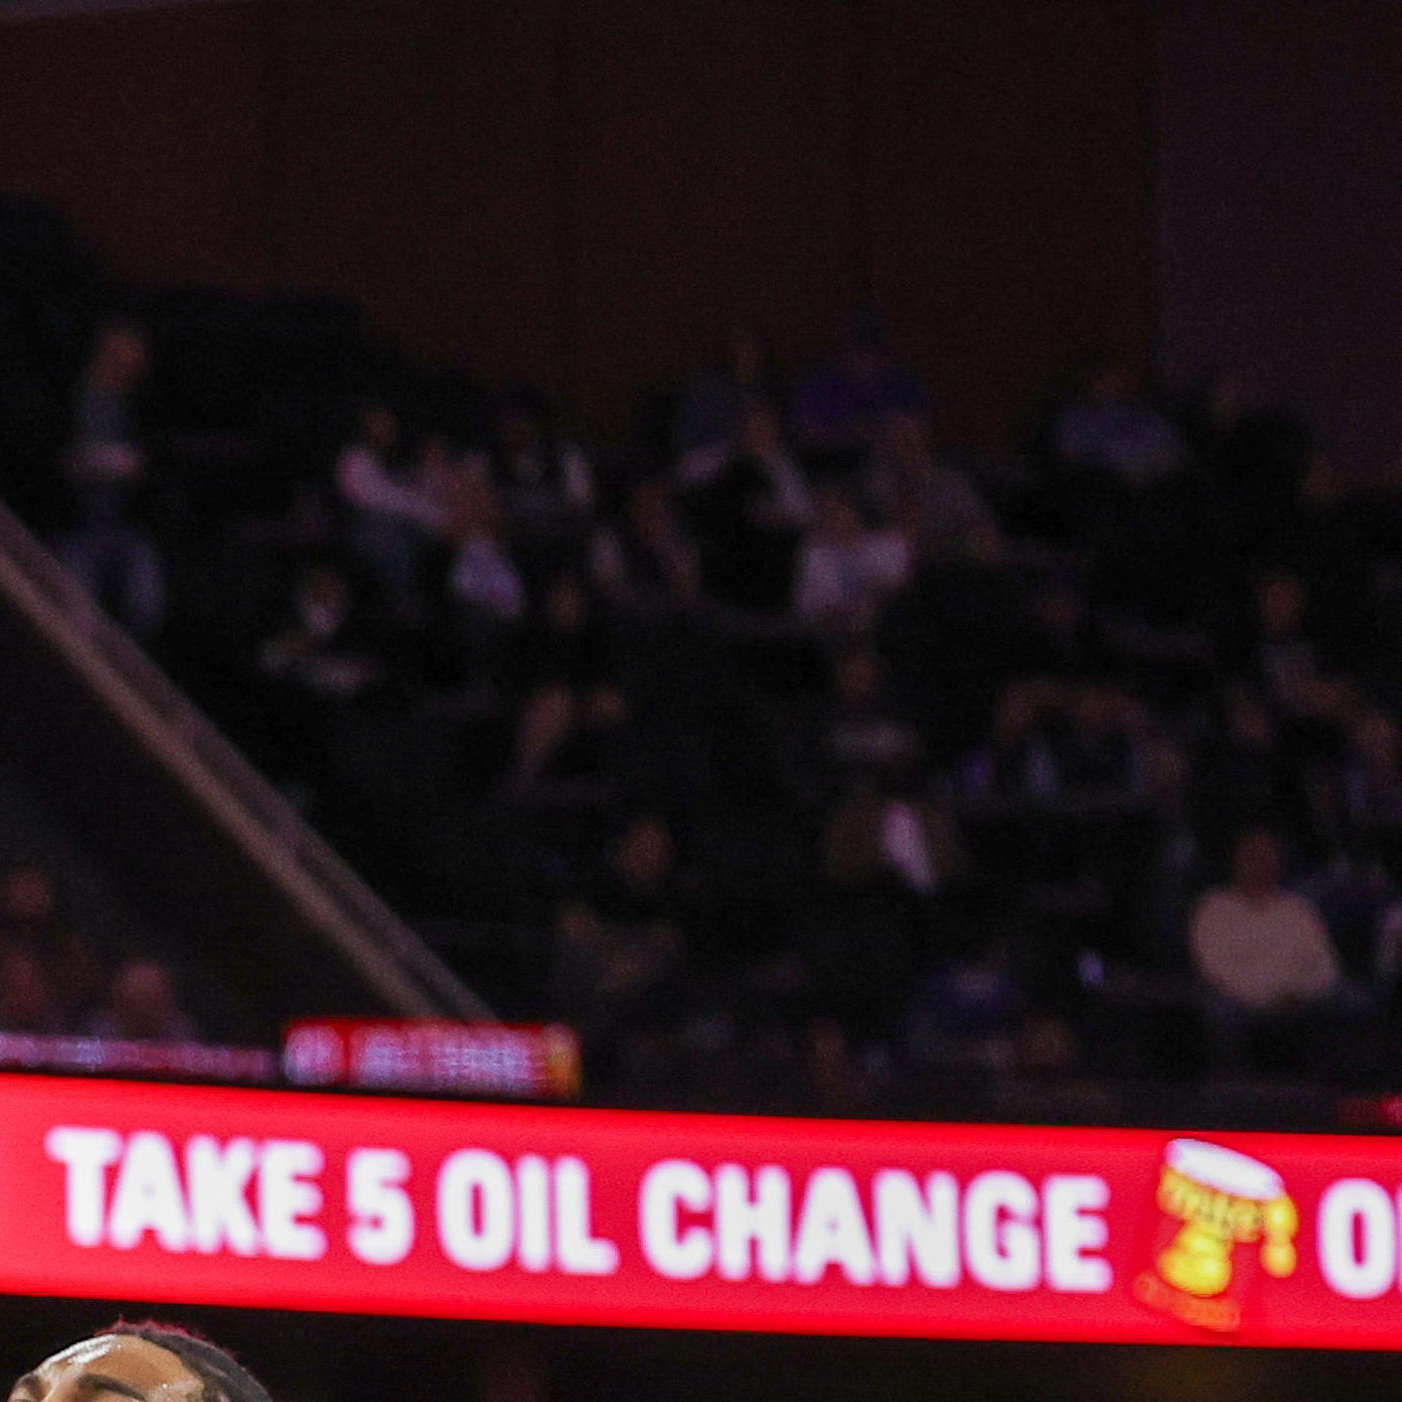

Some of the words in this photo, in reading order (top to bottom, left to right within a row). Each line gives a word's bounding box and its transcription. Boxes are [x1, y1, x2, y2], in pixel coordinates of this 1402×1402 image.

[45, 1126, 326, 1259] TAKE
[346, 1147, 414, 1265] 5
[436, 1149, 619, 1274] OIL
[639, 1159, 1112, 1292] CHANGE
[1317, 1177, 1402, 1299] O
